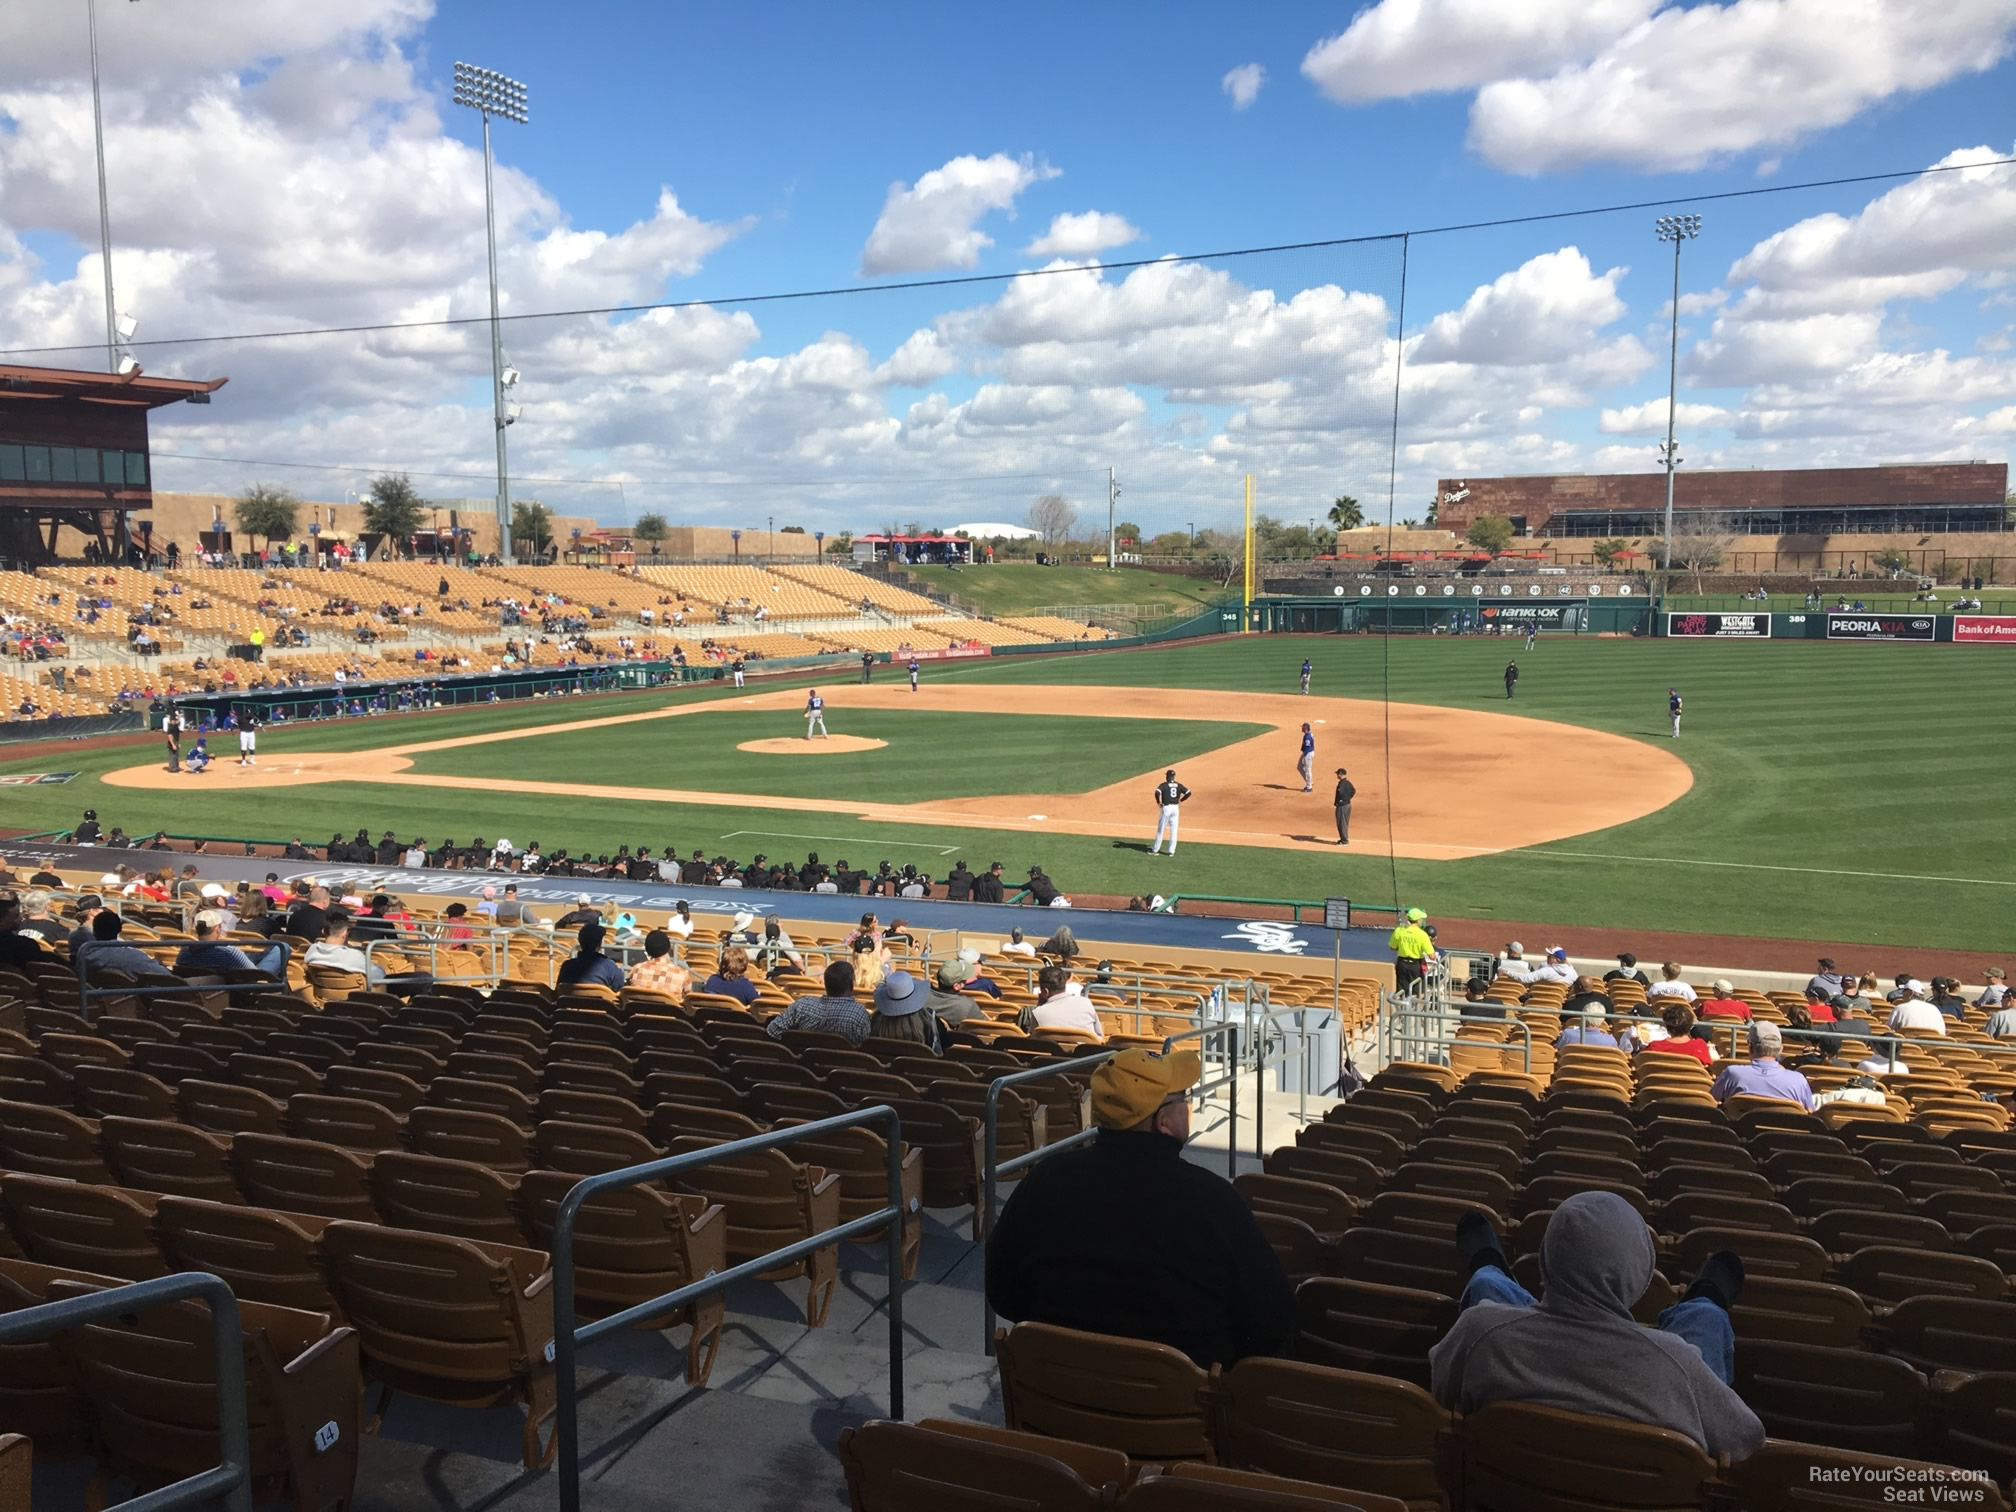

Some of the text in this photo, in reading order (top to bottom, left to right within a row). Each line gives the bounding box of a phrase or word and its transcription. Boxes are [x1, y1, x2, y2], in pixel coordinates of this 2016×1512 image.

[1222, 613, 1237, 621] 345
[1720, 616, 1756, 626] WESTGATE
[1958, 624, 1983, 634] Bank
[1984, 625, 1994, 634] of
[320, 1426, 334, 1446] 14
